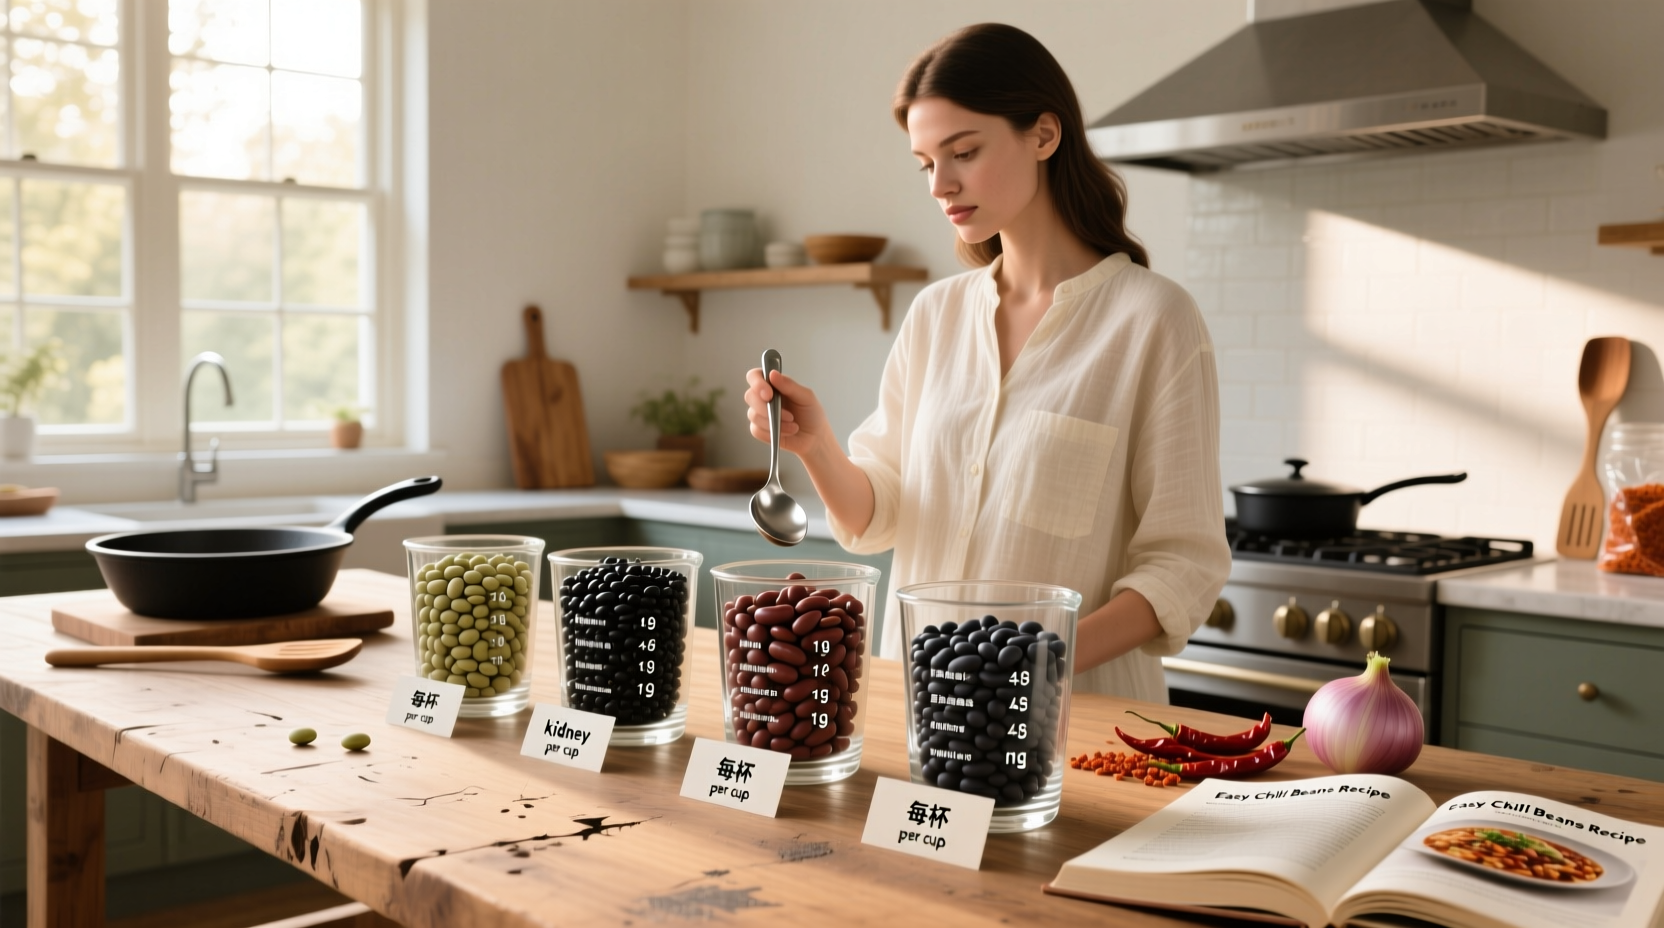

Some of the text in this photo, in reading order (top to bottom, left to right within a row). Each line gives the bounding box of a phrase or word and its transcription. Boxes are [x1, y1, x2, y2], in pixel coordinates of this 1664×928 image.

[411, 689, 440, 710] 每杯
[543, 718, 591, 746] kidney
[544, 743, 579, 760] per cup
[716, 756, 756, 784] 每杯
[709, 784, 750, 803] per cup
[1338, 785, 1391, 800] Recipe
[906, 800, 951, 829] 每杯
[1533, 807, 1585, 830] Beans
[1588, 823, 1647, 845] Recipe
[897, 830, 947, 851] per cup
